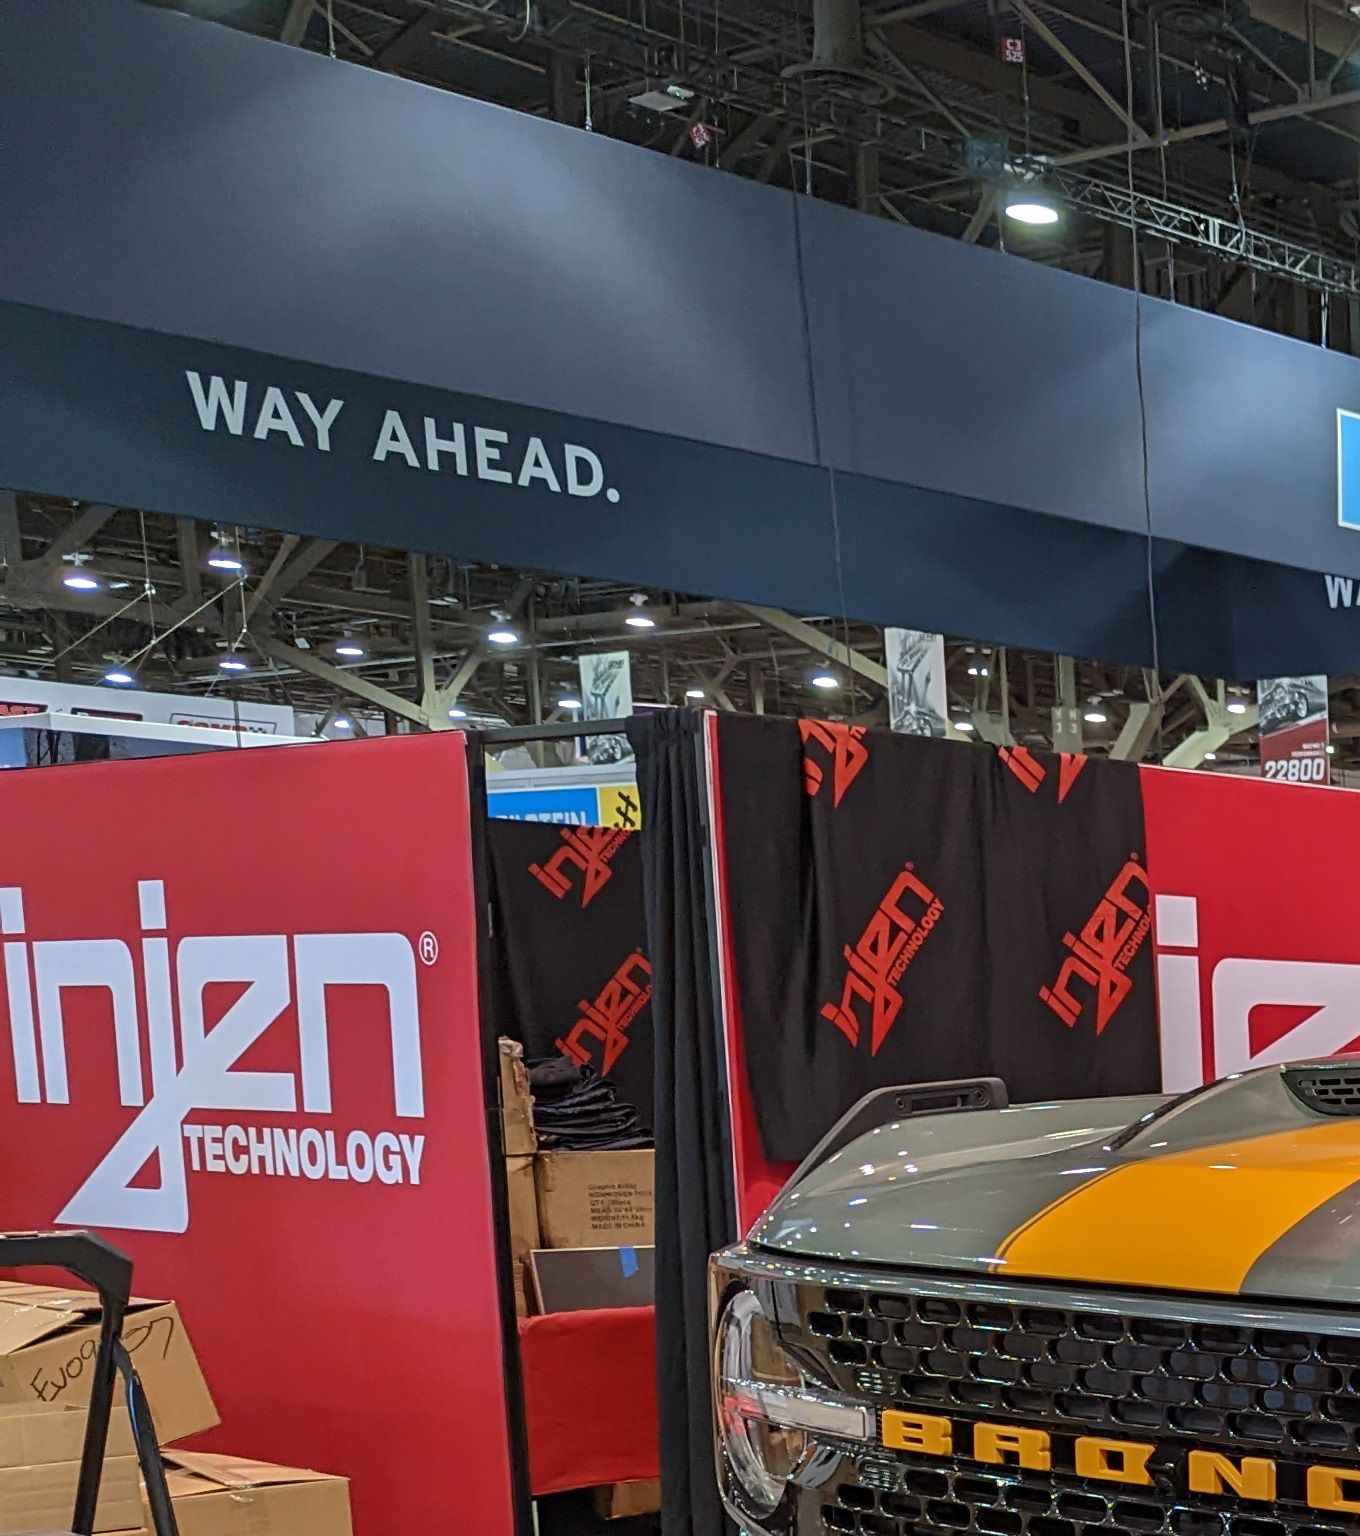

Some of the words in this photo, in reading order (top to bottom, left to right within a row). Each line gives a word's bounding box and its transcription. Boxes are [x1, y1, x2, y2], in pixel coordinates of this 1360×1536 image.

[185, 370, 343, 451] WAY
[372, 409, 623, 504] AHEAD.
[1265, 757, 1326, 781] 22800
[887, 896, 945, 987] TECHNOLOGY
[183, 1124, 426, 1187] TECHNOLOGY
